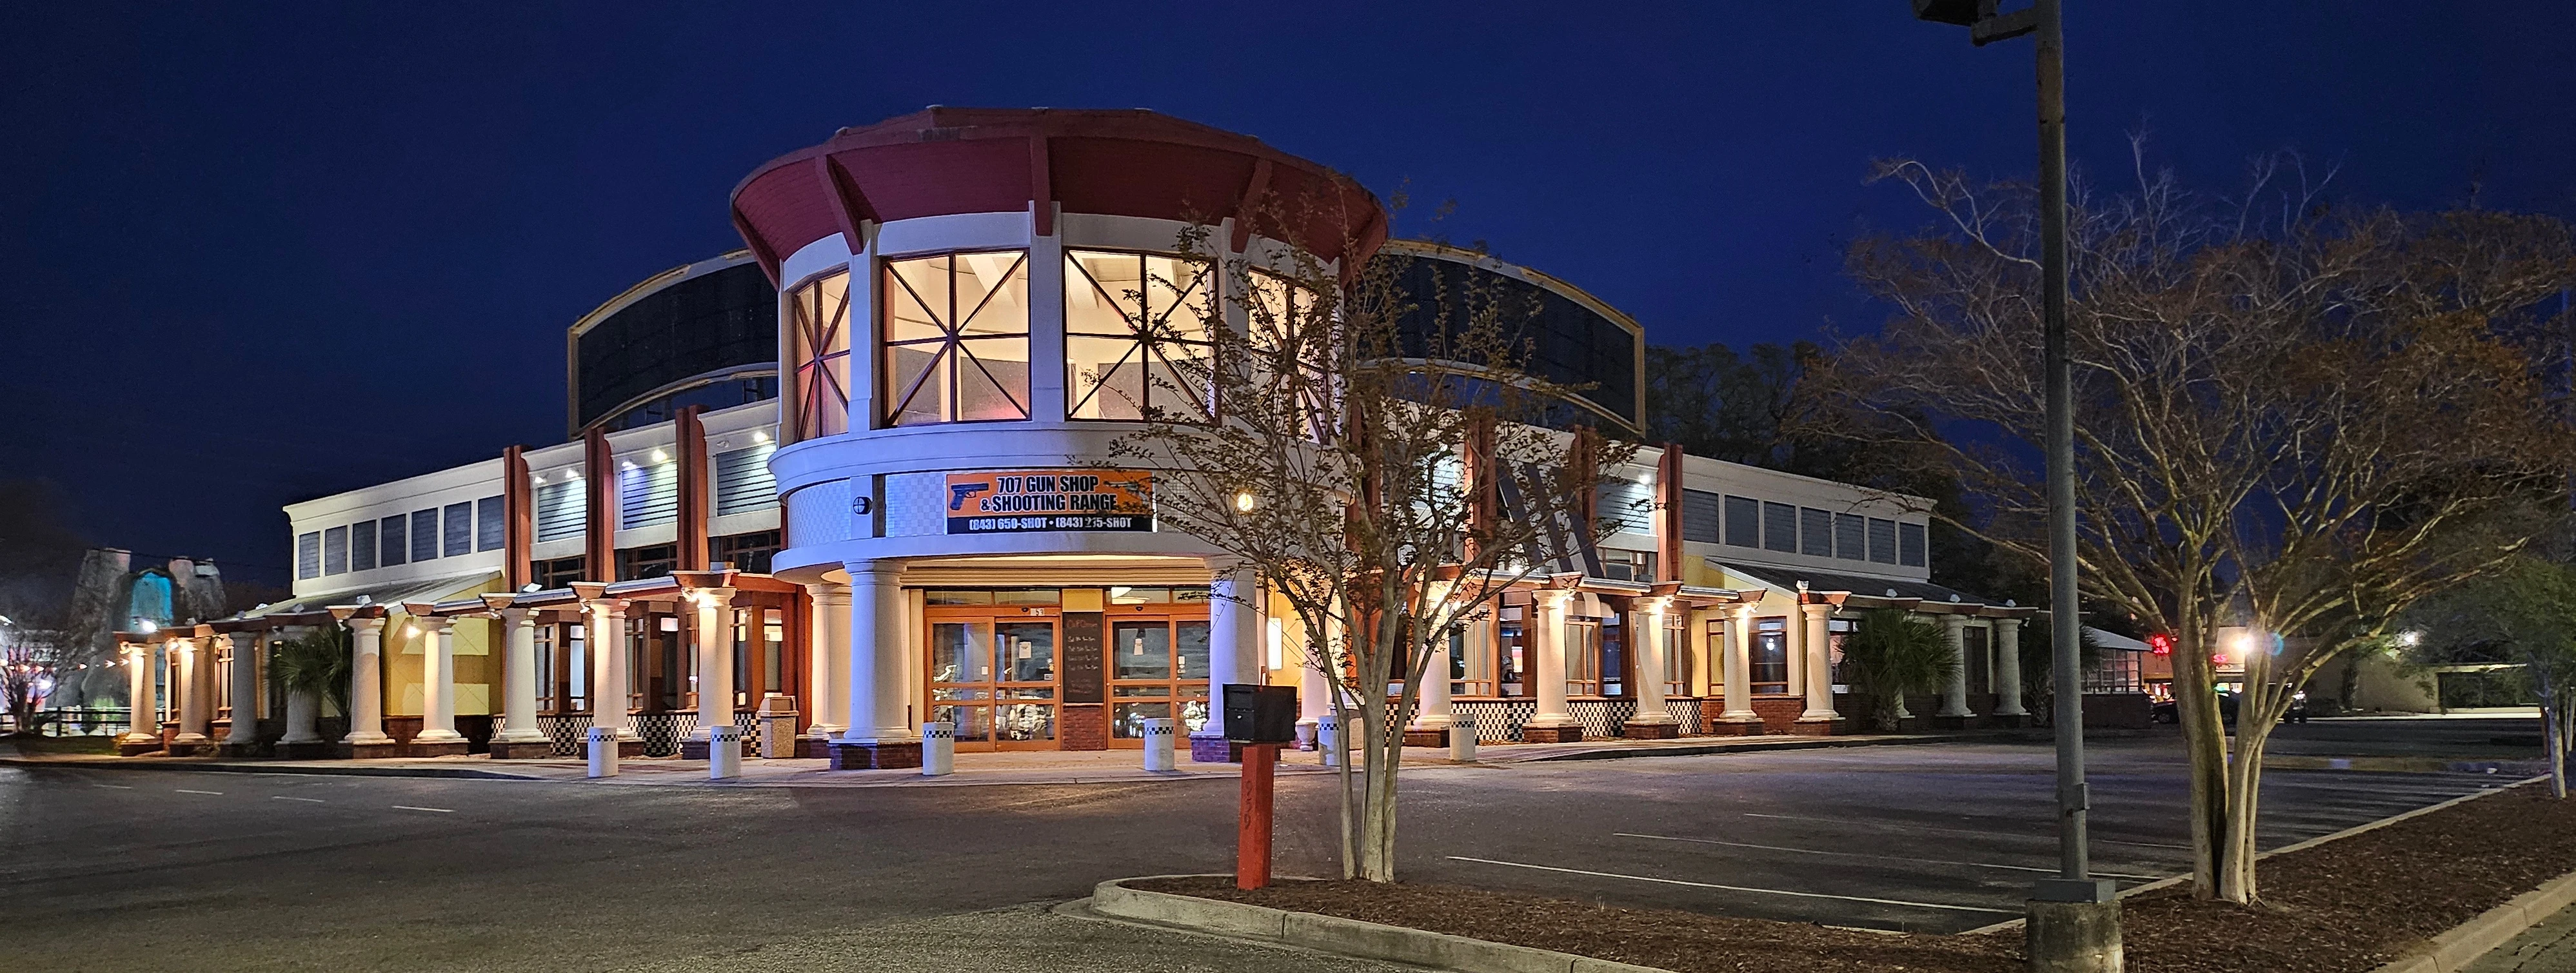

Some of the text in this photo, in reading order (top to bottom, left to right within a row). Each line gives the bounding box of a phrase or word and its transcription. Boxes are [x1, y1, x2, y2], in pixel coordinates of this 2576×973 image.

[997, 475, 1099, 493] 707 GUN SHOP
[980, 493, 1118, 512] & SHOOTING RANGE
[969, 518, 996, 531] (843)
[997, 517, 1047, 529] 650-SHOT
[1055, 517, 1083, 528] (843)
